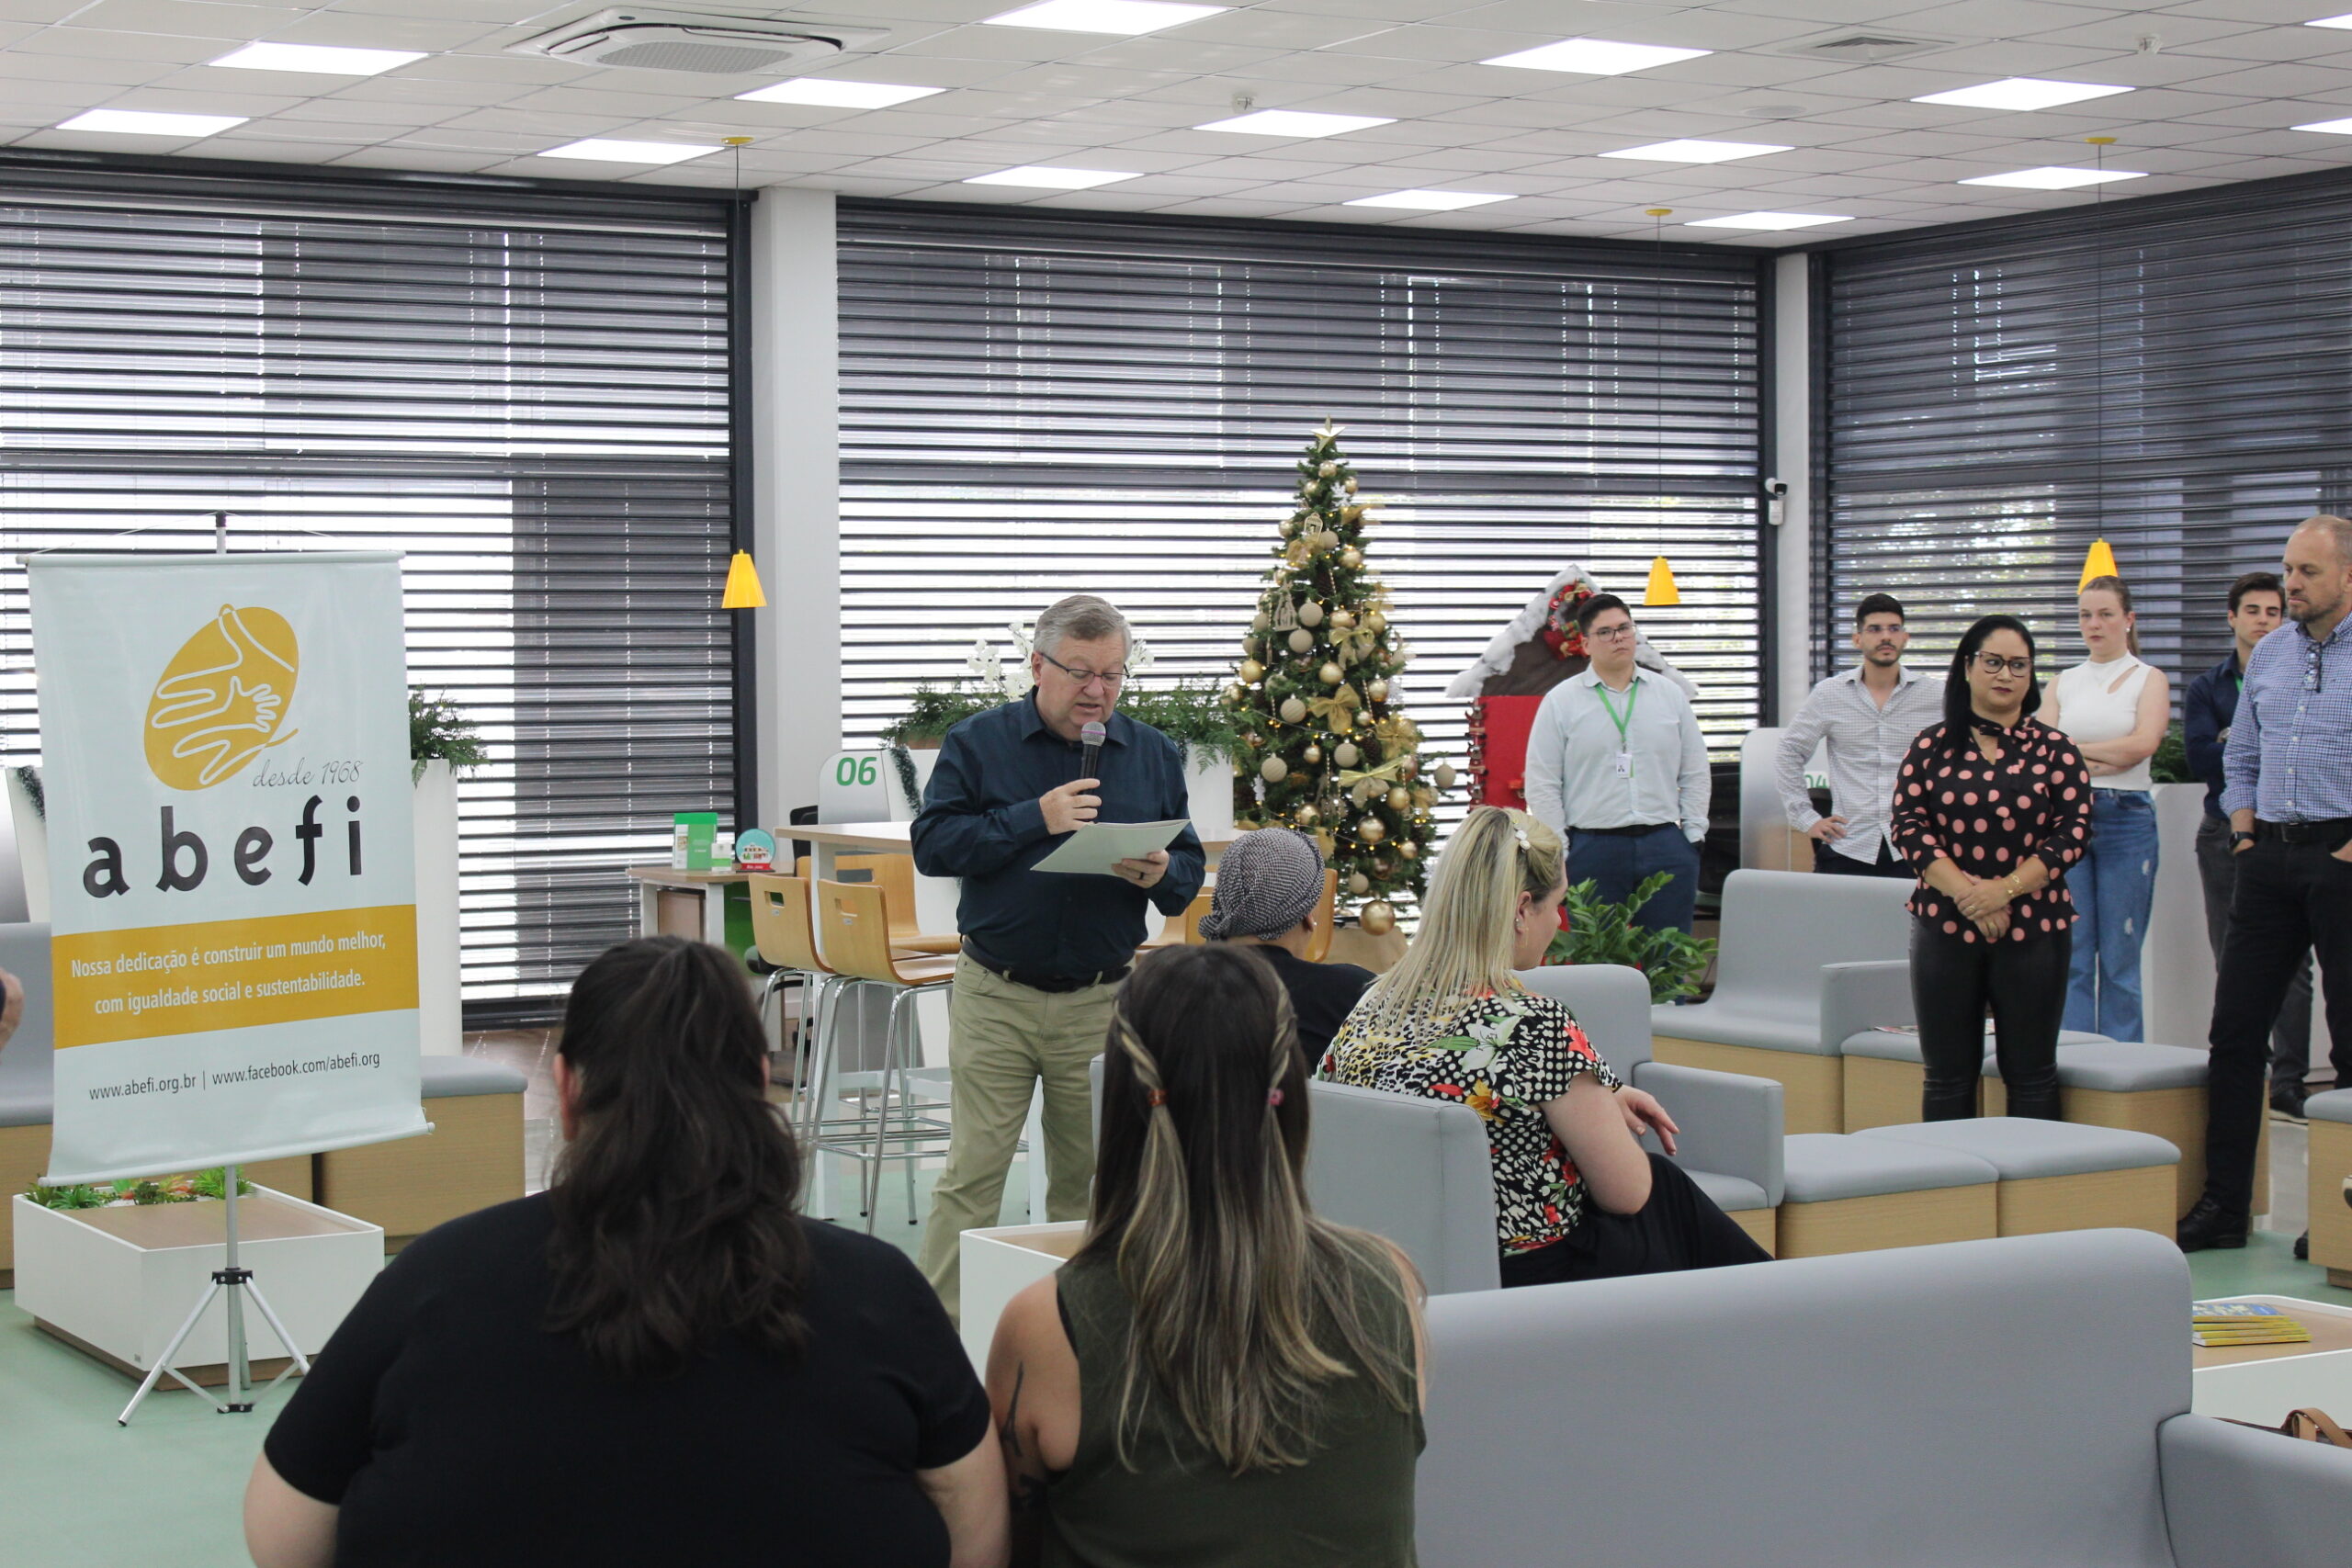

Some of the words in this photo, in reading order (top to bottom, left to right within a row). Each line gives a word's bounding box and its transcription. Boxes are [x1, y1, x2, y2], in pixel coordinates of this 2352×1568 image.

[253, 758, 316, 788] desde
[321, 759, 364, 784] 1968
[836, 756, 877, 786] 06
[83, 795, 363, 898] abefi
[72, 959, 112, 978] Nossa
[116, 950, 187, 975] dedicação
[191, 946, 199, 965] é
[204, 942, 263, 964] construir
[266, 943, 287, 959] um
[290, 934, 334, 956] mundo
[338, 931, 386, 951] melhor,
[95, 997, 124, 1014] com
[128, 986, 198, 1015] igualdade
[202, 980, 241, 1003] social
[244, 985, 253, 998] e
[256, 968, 366, 998] sustentabilidade.
[89, 1073, 197, 1100] www.abefi.org.br
[212, 1052, 380, 1086] www.facebook.com/abefi.org
